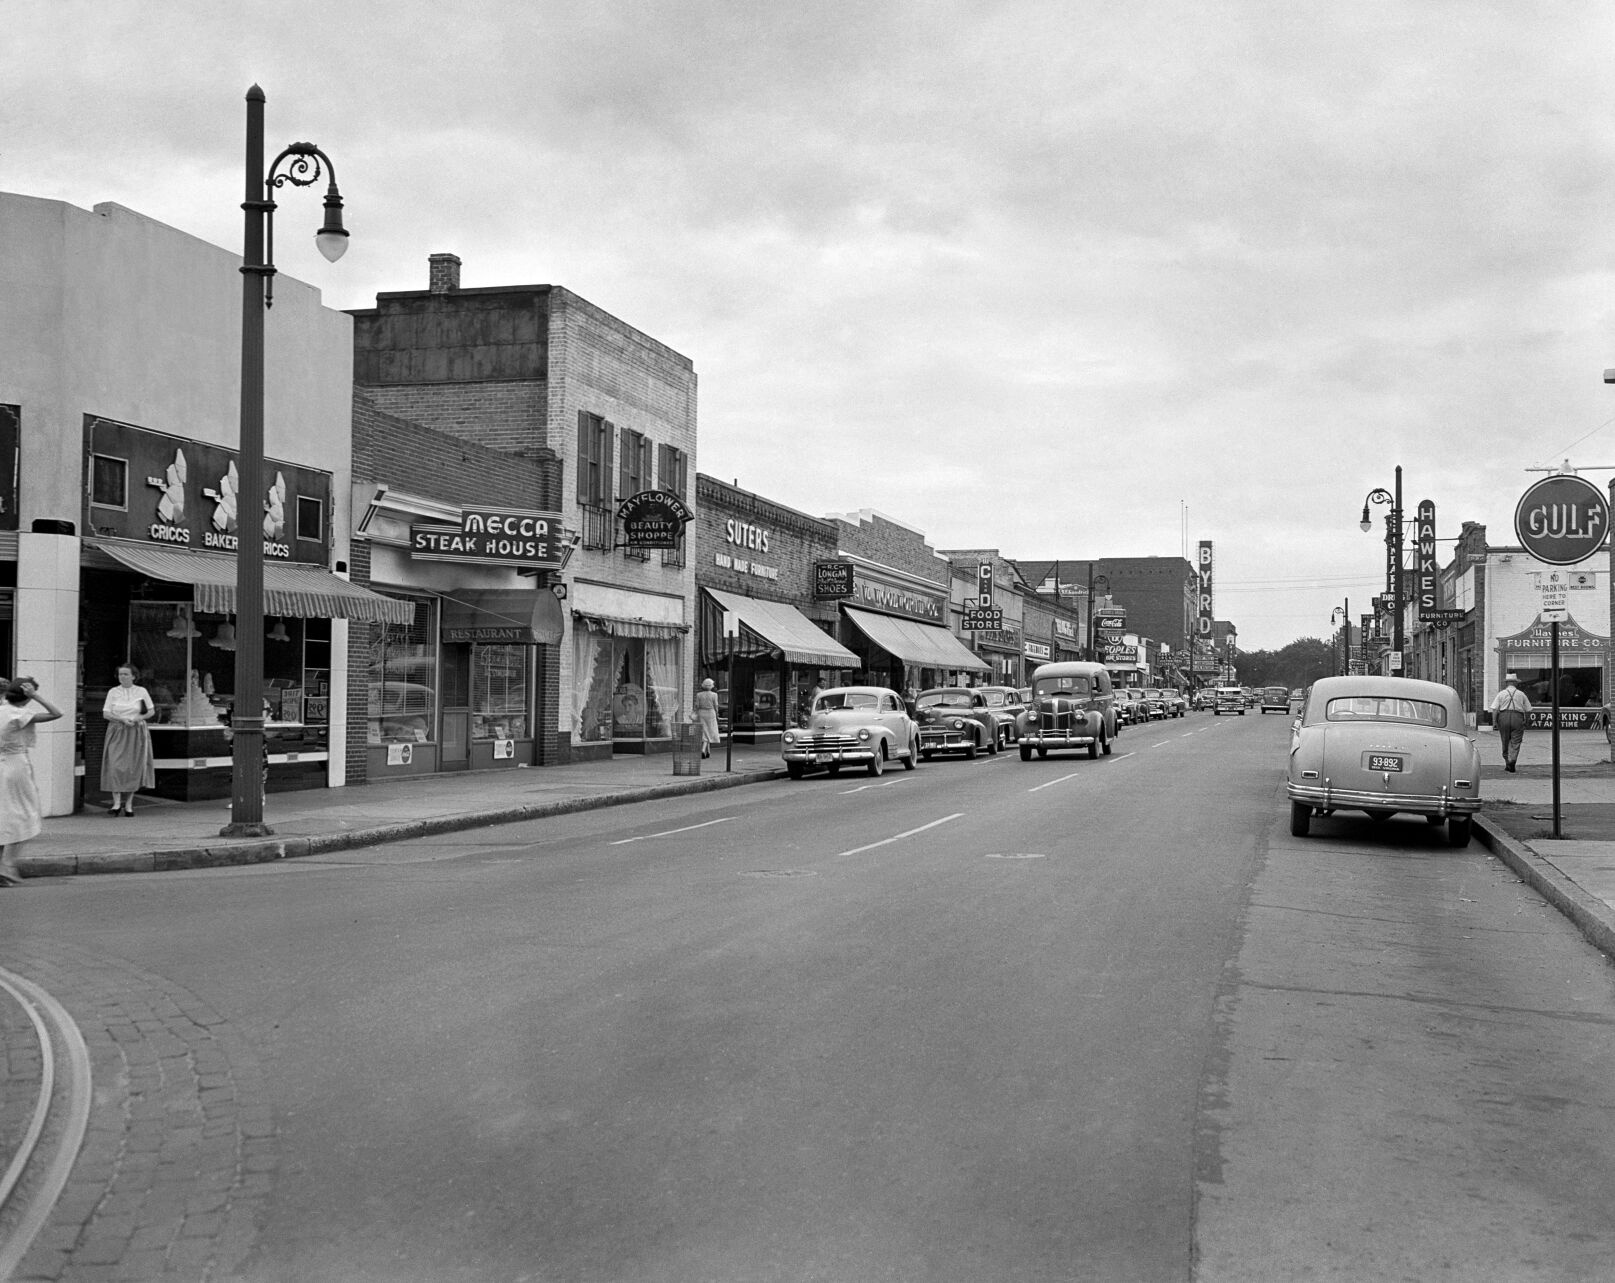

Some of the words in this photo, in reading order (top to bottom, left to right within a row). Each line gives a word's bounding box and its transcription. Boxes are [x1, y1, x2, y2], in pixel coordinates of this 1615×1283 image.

[620, 493, 685, 518] MAYFLOWER
[464, 514, 549, 537] MECCA
[630, 521, 673, 530] BEAUTY
[1527, 503, 1602, 539] GULF
[630, 532, 673, 541] SHOPPE
[726, 519, 770, 553] SUTERS
[204, 532, 239, 550] BAKER
[263, 541, 290, 557] RICCS
[415, 533, 478, 552] STEAK
[485, 539, 548, 558] HOUSE
[715, 553, 731, 569] HAND
[1420, 507, 1434, 608] HAWKES
[818, 568, 848, 579] LONGAN
[980, 565, 991, 579] C
[1550, 574, 1560, 583] NO
[818, 584, 848, 593] SHOES
[1200, 547, 1212, 634] BYRD
[1542, 584, 1568, 593] PARKING
[980, 594, 991, 607] D
[970, 610, 1001, 619] FOOD
[963, 620, 1001, 629] STORE
[450, 628, 522, 640] RESTAURANT
[1507, 639, 1579, 648] FURNITRE
[1540, 712, 1588, 722] PAKING
